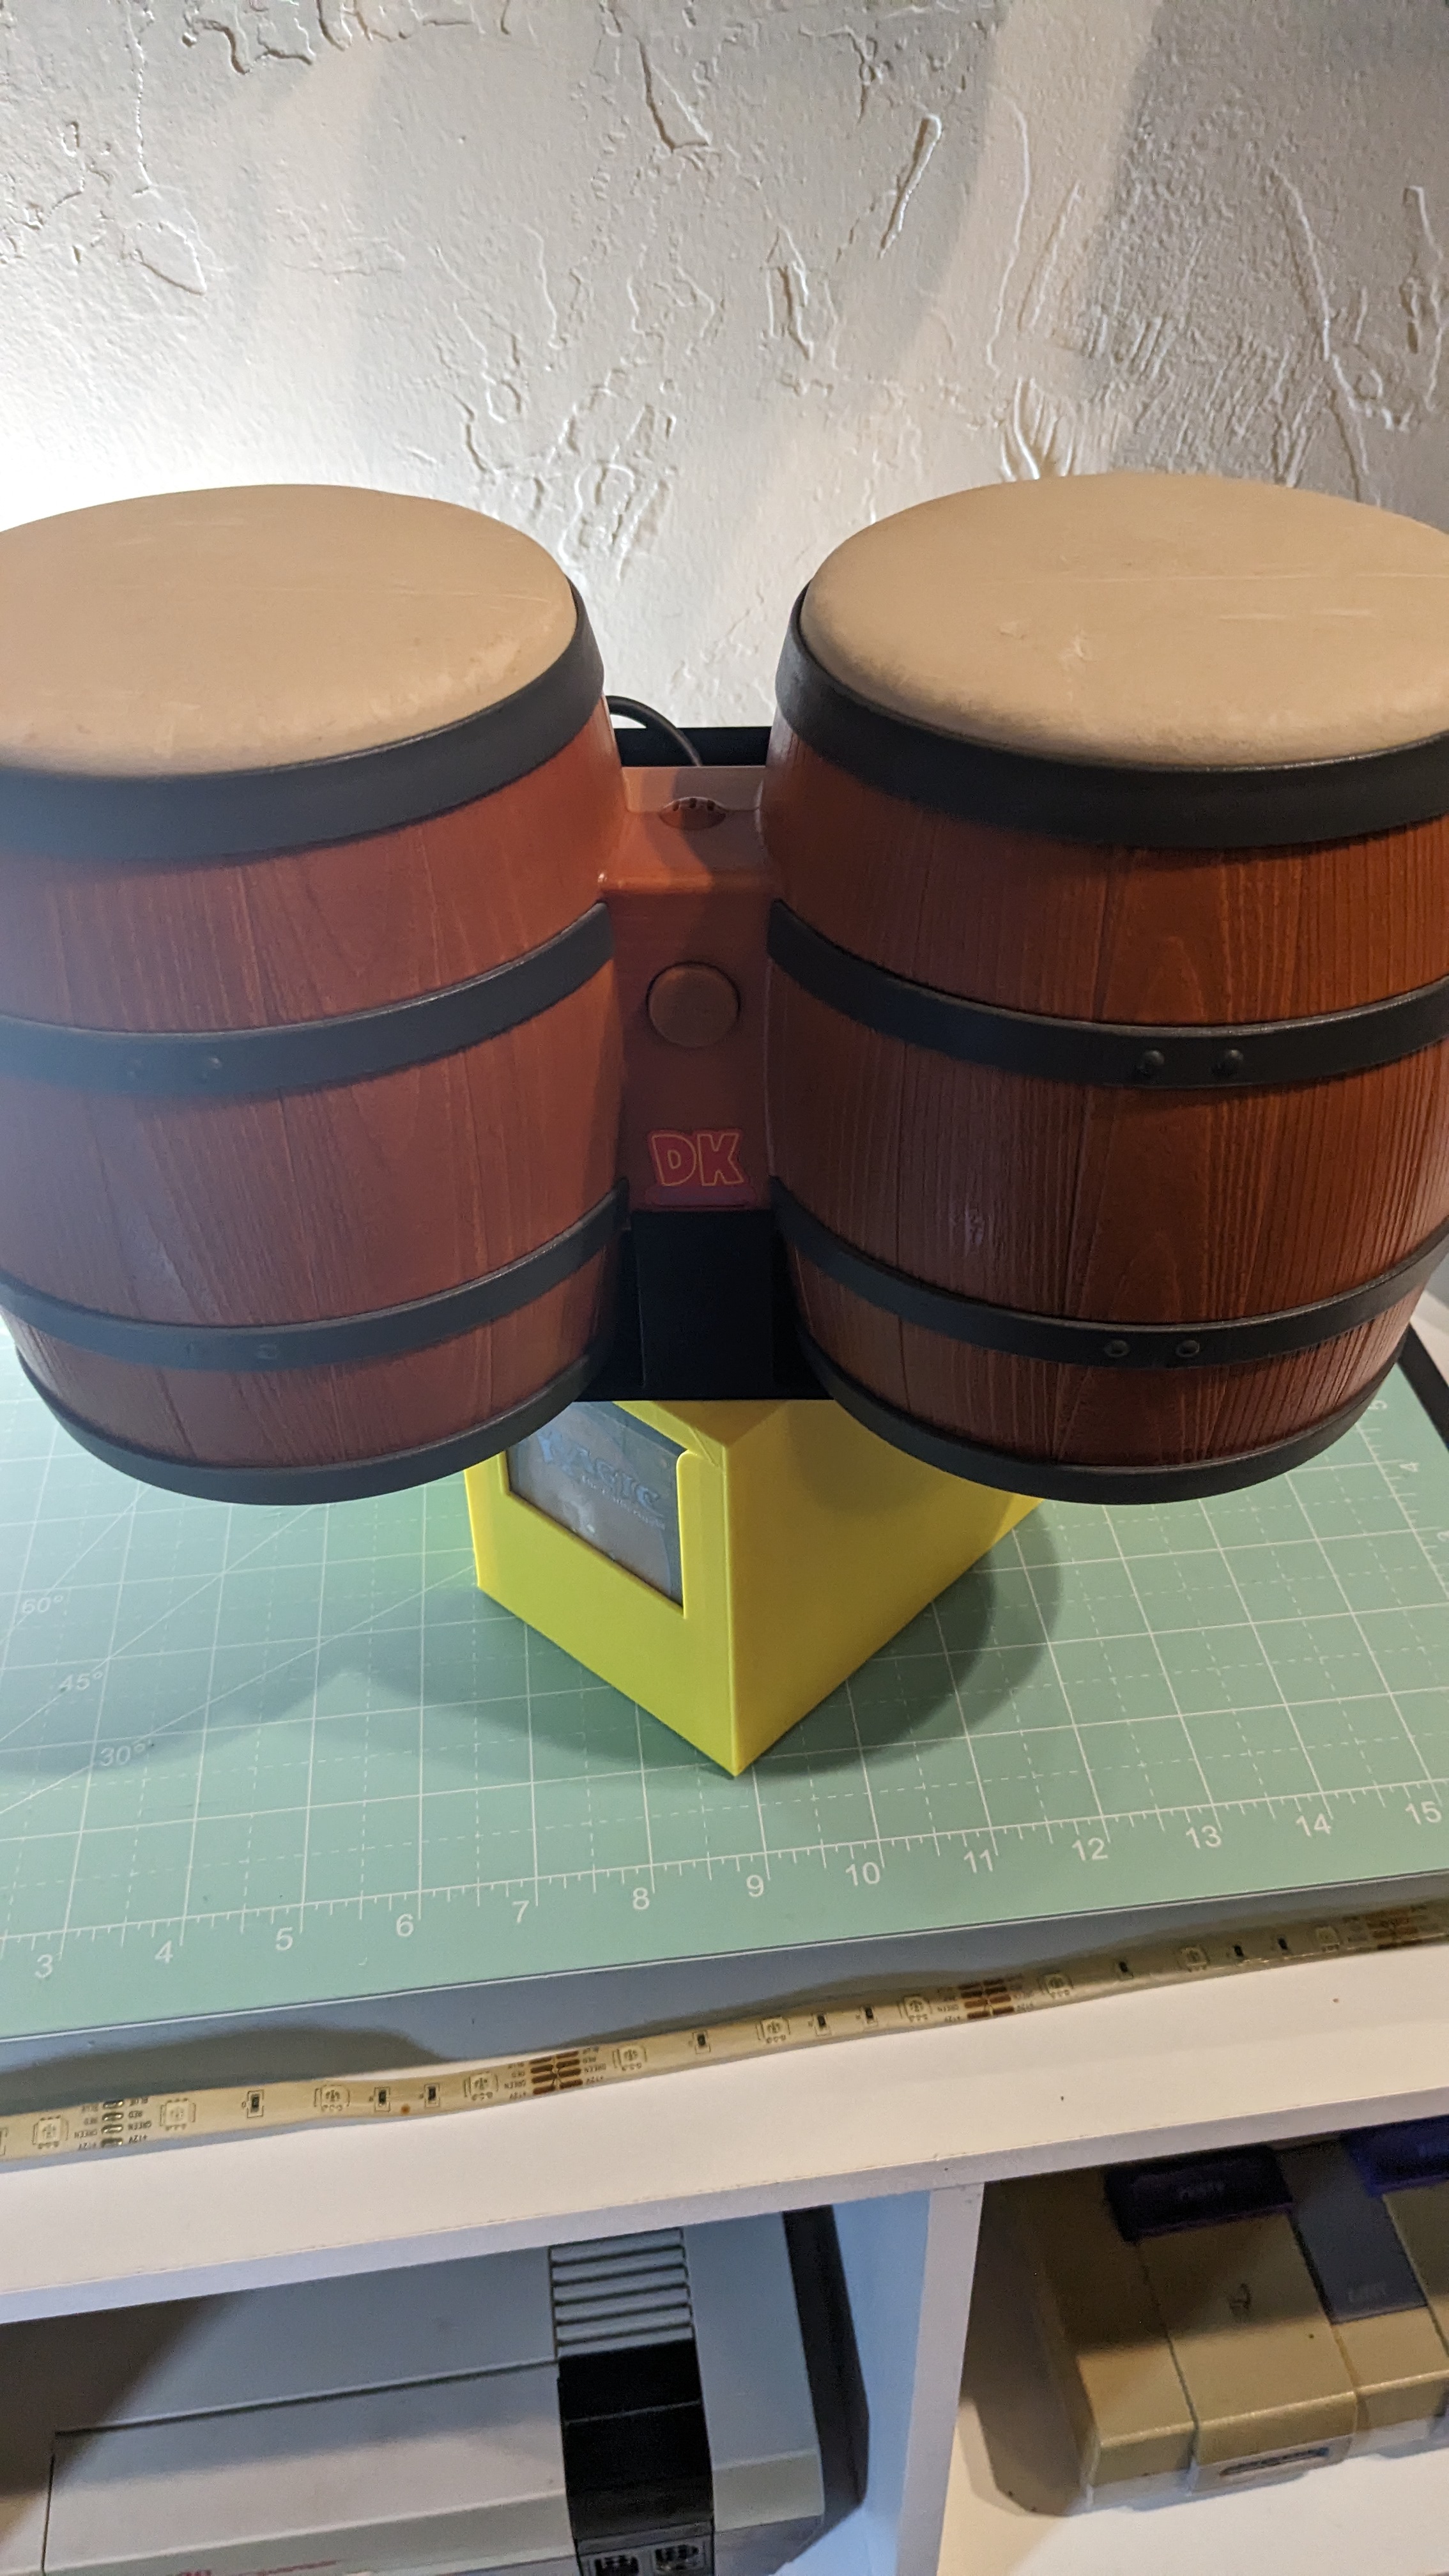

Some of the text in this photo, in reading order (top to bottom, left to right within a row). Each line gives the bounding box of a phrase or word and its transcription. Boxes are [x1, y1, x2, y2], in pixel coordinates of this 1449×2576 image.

[651, 1133, 744, 1186] DK
[1399, 1462, 1419, 1472] 4
[22, 1596, 63, 1614] 60°
[58, 1671, 103, 1691] 45°
[99, 1743, 146, 1767] 30°
[35, 1800, 1441, 1978] 3 4 5 6 7 8 9 10 11 12 13 14 15
[128, 2120, 152, 2130] GREEN
[128, 2134, 148, 2143] +12V
